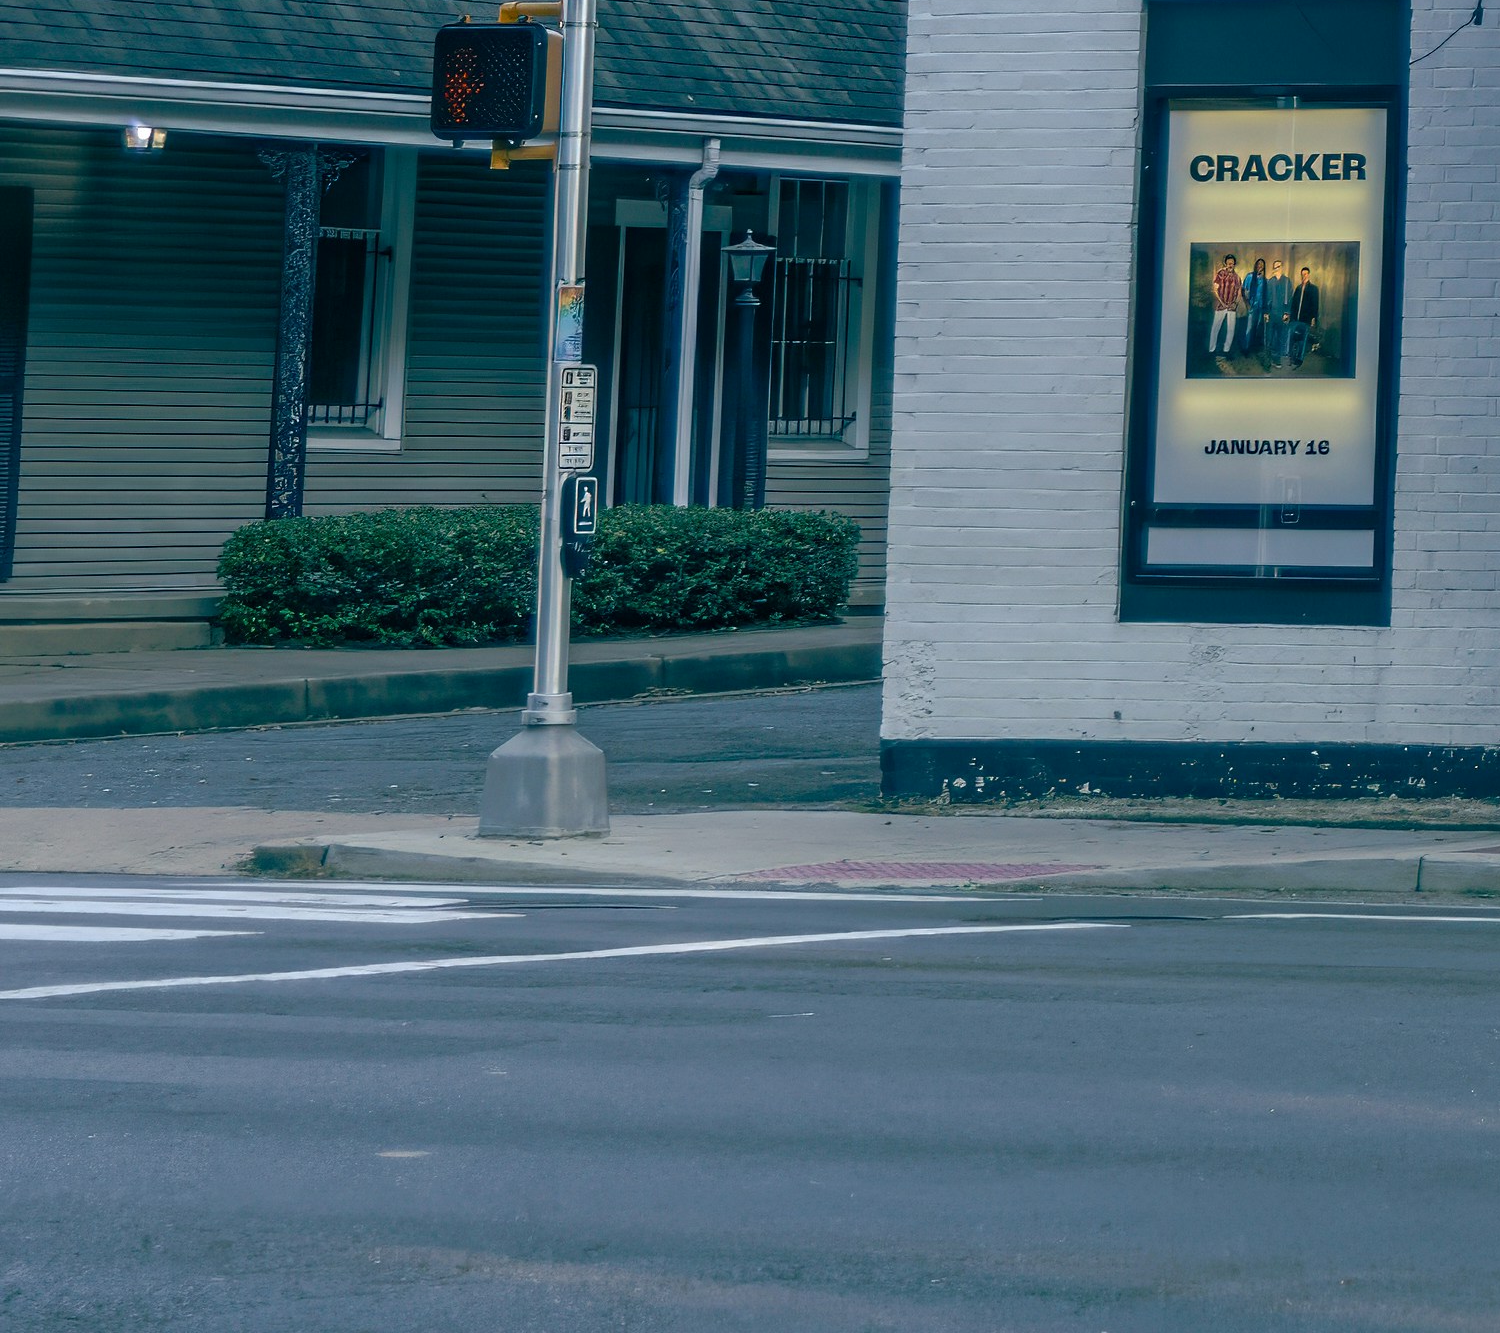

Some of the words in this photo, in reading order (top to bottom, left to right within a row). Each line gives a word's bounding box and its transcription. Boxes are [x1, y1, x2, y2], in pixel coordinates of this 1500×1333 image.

[1189, 152, 1368, 183] CRACKER
[1204, 438, 1300, 457] JANUARY
[1305, 439, 1330, 456] 16
